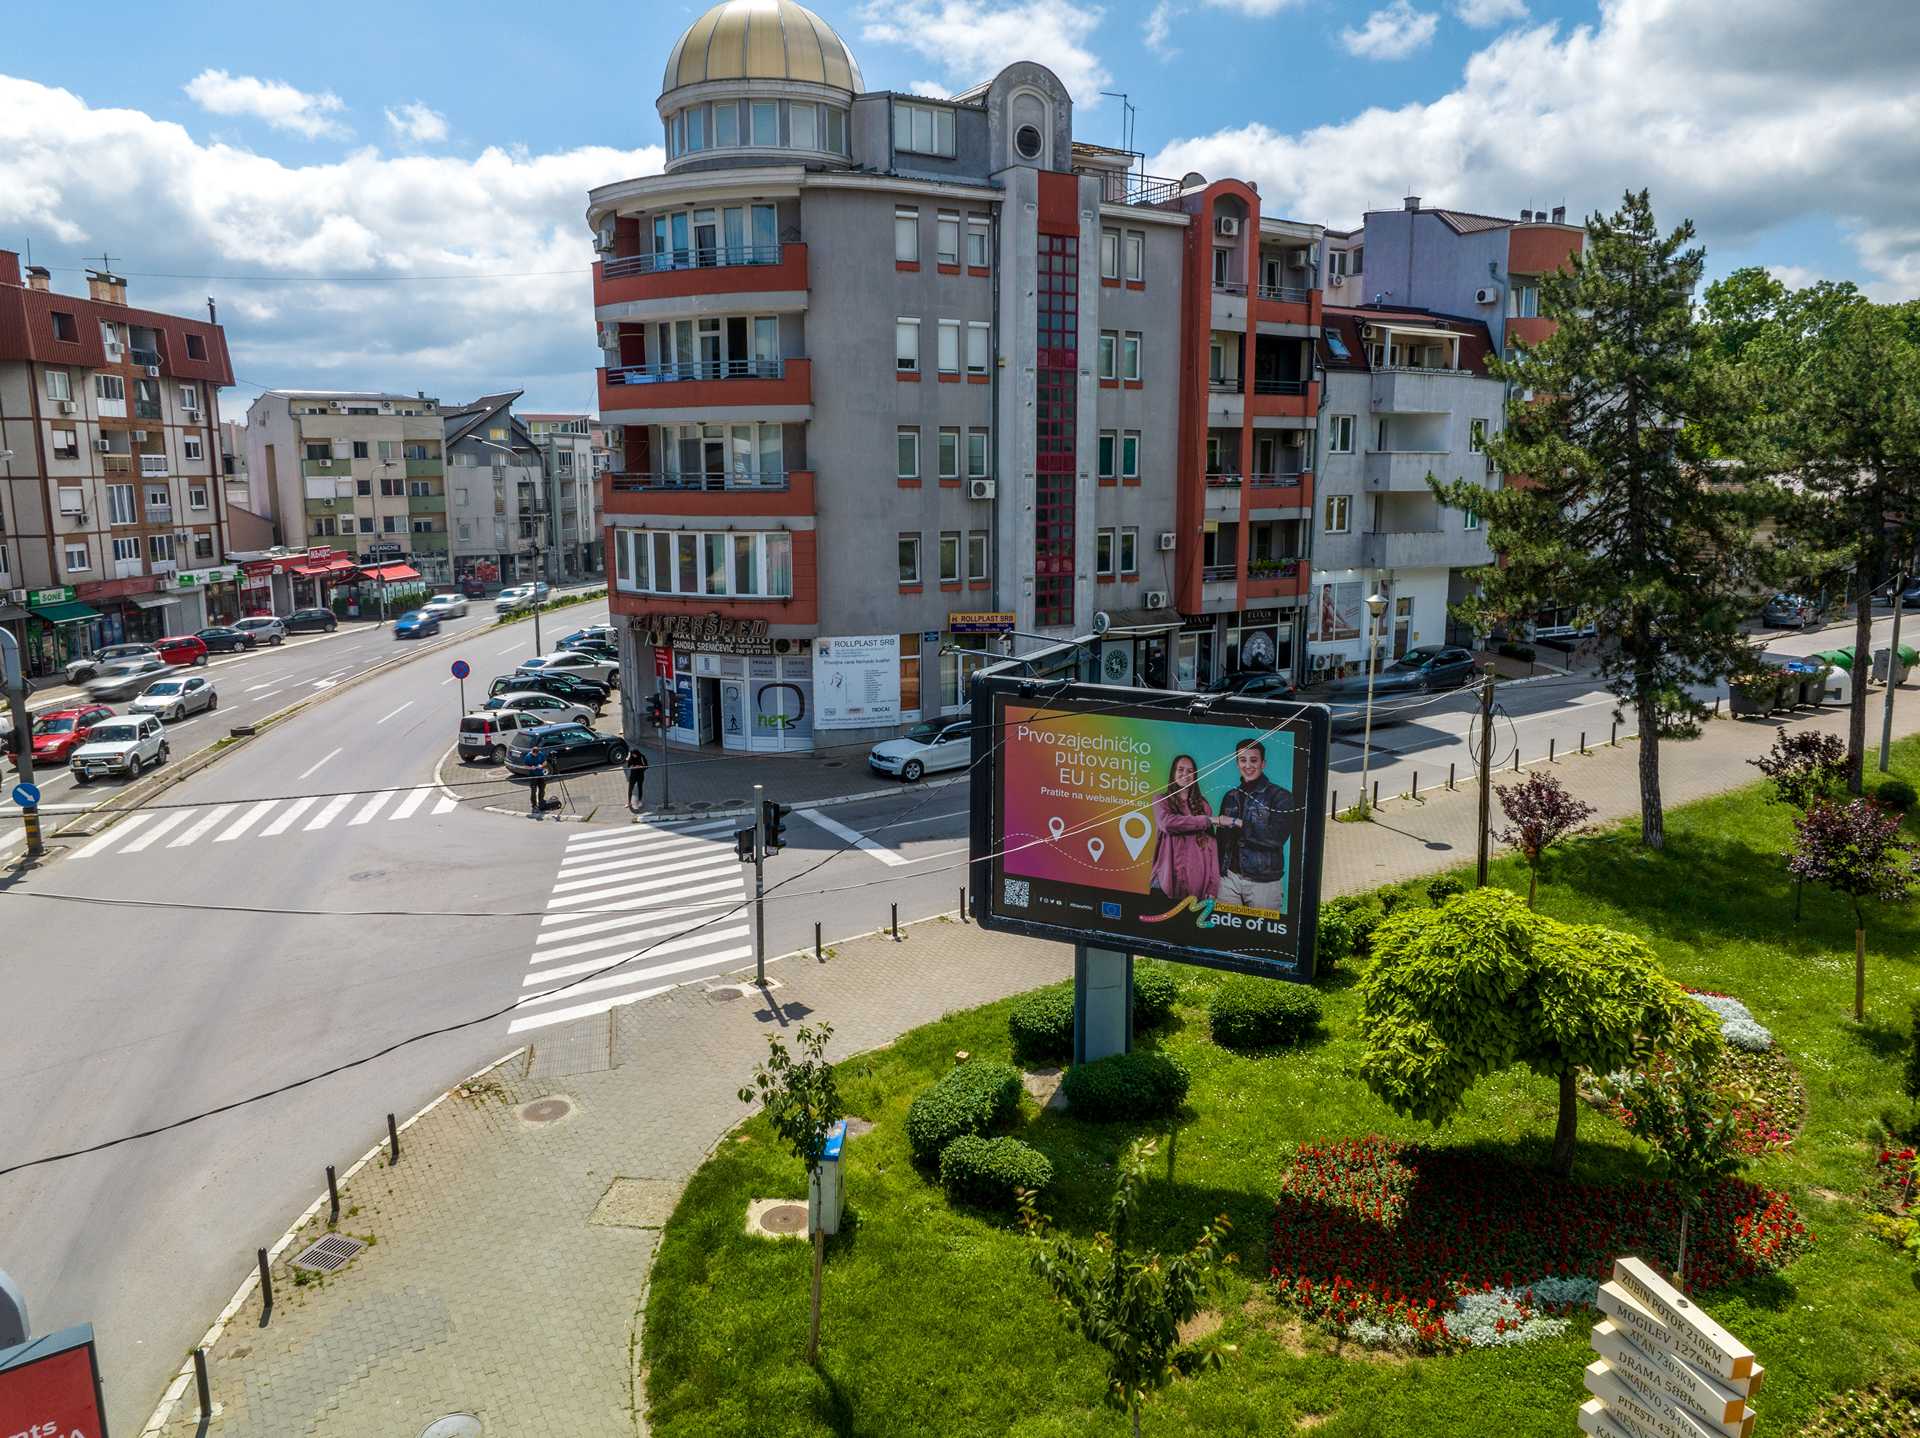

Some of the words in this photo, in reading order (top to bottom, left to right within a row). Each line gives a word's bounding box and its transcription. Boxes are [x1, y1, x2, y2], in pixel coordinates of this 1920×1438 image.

[960, 615, 998, 623] ROLLPLAST
[673, 639, 696, 651] SANDRA
[834, 640, 878, 648] ROLLPLAST
[880, 639, 895, 647] SRB
[1018, 725, 1055, 743] Prvo
[1057, 733, 1152, 756] zajedničko
[1055, 751, 1151, 776] putovanje
[1040, 786, 1070, 798] Pratite
[1072, 791, 1083, 800] na
[1060, 767, 1084, 786] EU
[1090, 772, 1095, 787] i
[1099, 773, 1150, 796] Srbije
[1215, 902, 1262, 916] Possibilities
[1264, 910, 1278, 919] are
[1245, 917, 1264, 932] of
[1266, 921, 1288, 935] us
[1617, 1304, 1672, 1344] MOGILEV
[1622, 1272, 1651, 1304] ZUBIN
[1651, 1298, 1686, 1333] POTOK
[1686, 1327, 1722, 1364] 210KM
[1618, 1351, 1662, 1387] DRAMA
[1657, 1349, 1697, 1393] 7303KM
[1664, 1403, 1697, 1438] 294KM
